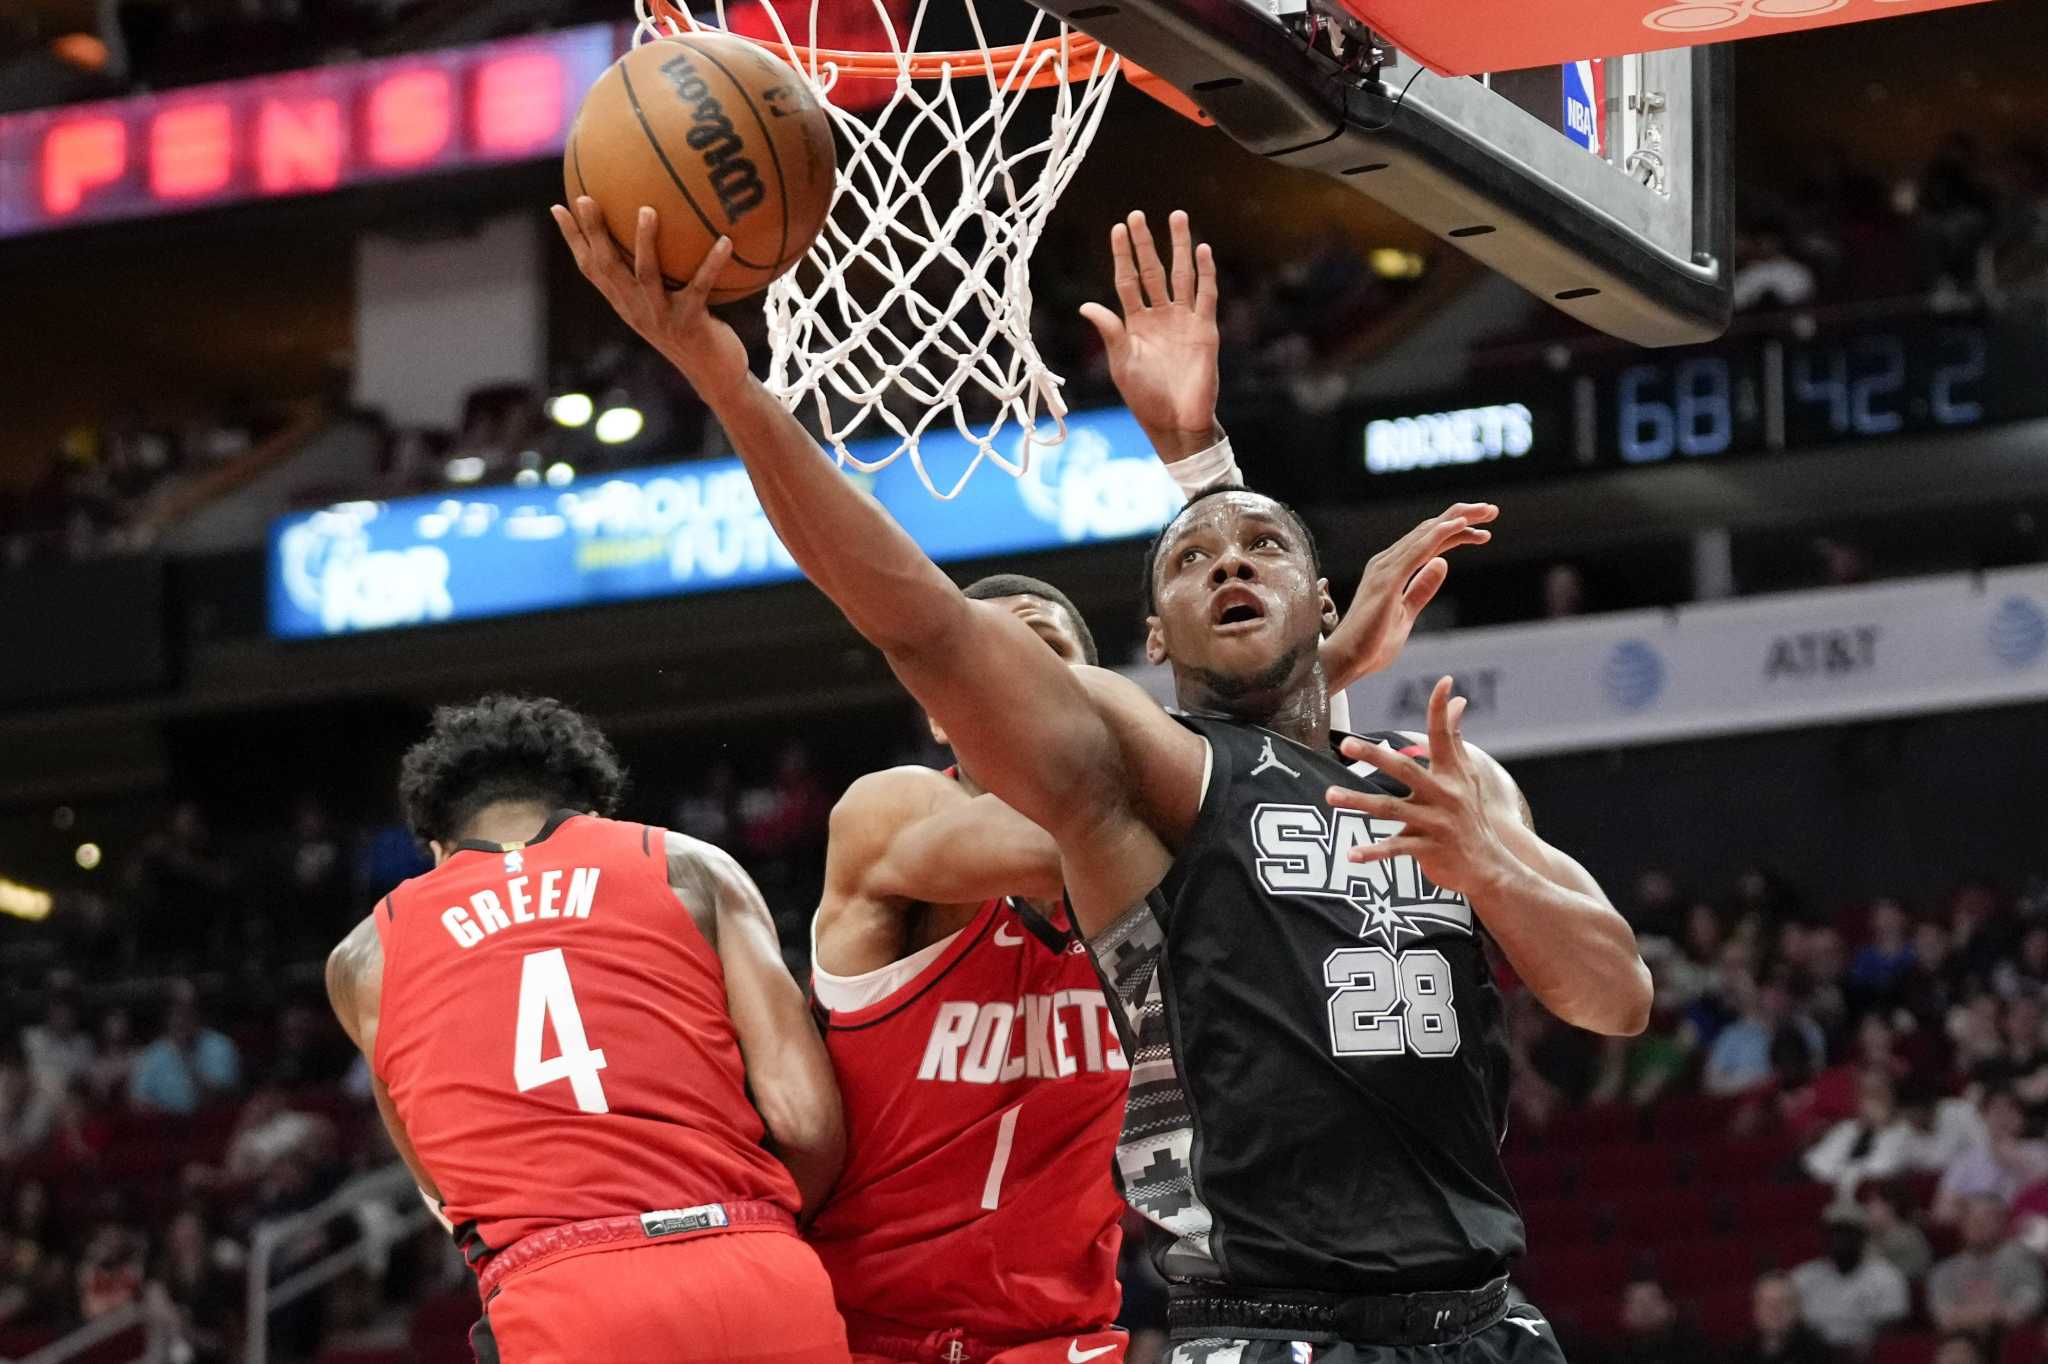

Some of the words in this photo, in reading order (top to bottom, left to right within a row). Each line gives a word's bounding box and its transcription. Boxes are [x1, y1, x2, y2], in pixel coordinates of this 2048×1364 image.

[660, 54, 765, 225] Wilson
[1567, 96, 1594, 136] NBA
[1366, 404, 1533, 470] ROCKETS
[1616, 358, 1733, 466] 68
[1763, 624, 1884, 682] AT&T
[1251, 803, 1472, 902] SAT
[440, 867, 601, 949] GREEN
[513, 947, 610, 1114] 4
[1322, 946, 1461, 1058] 28
[980, 1102, 1024, 1211] 1
